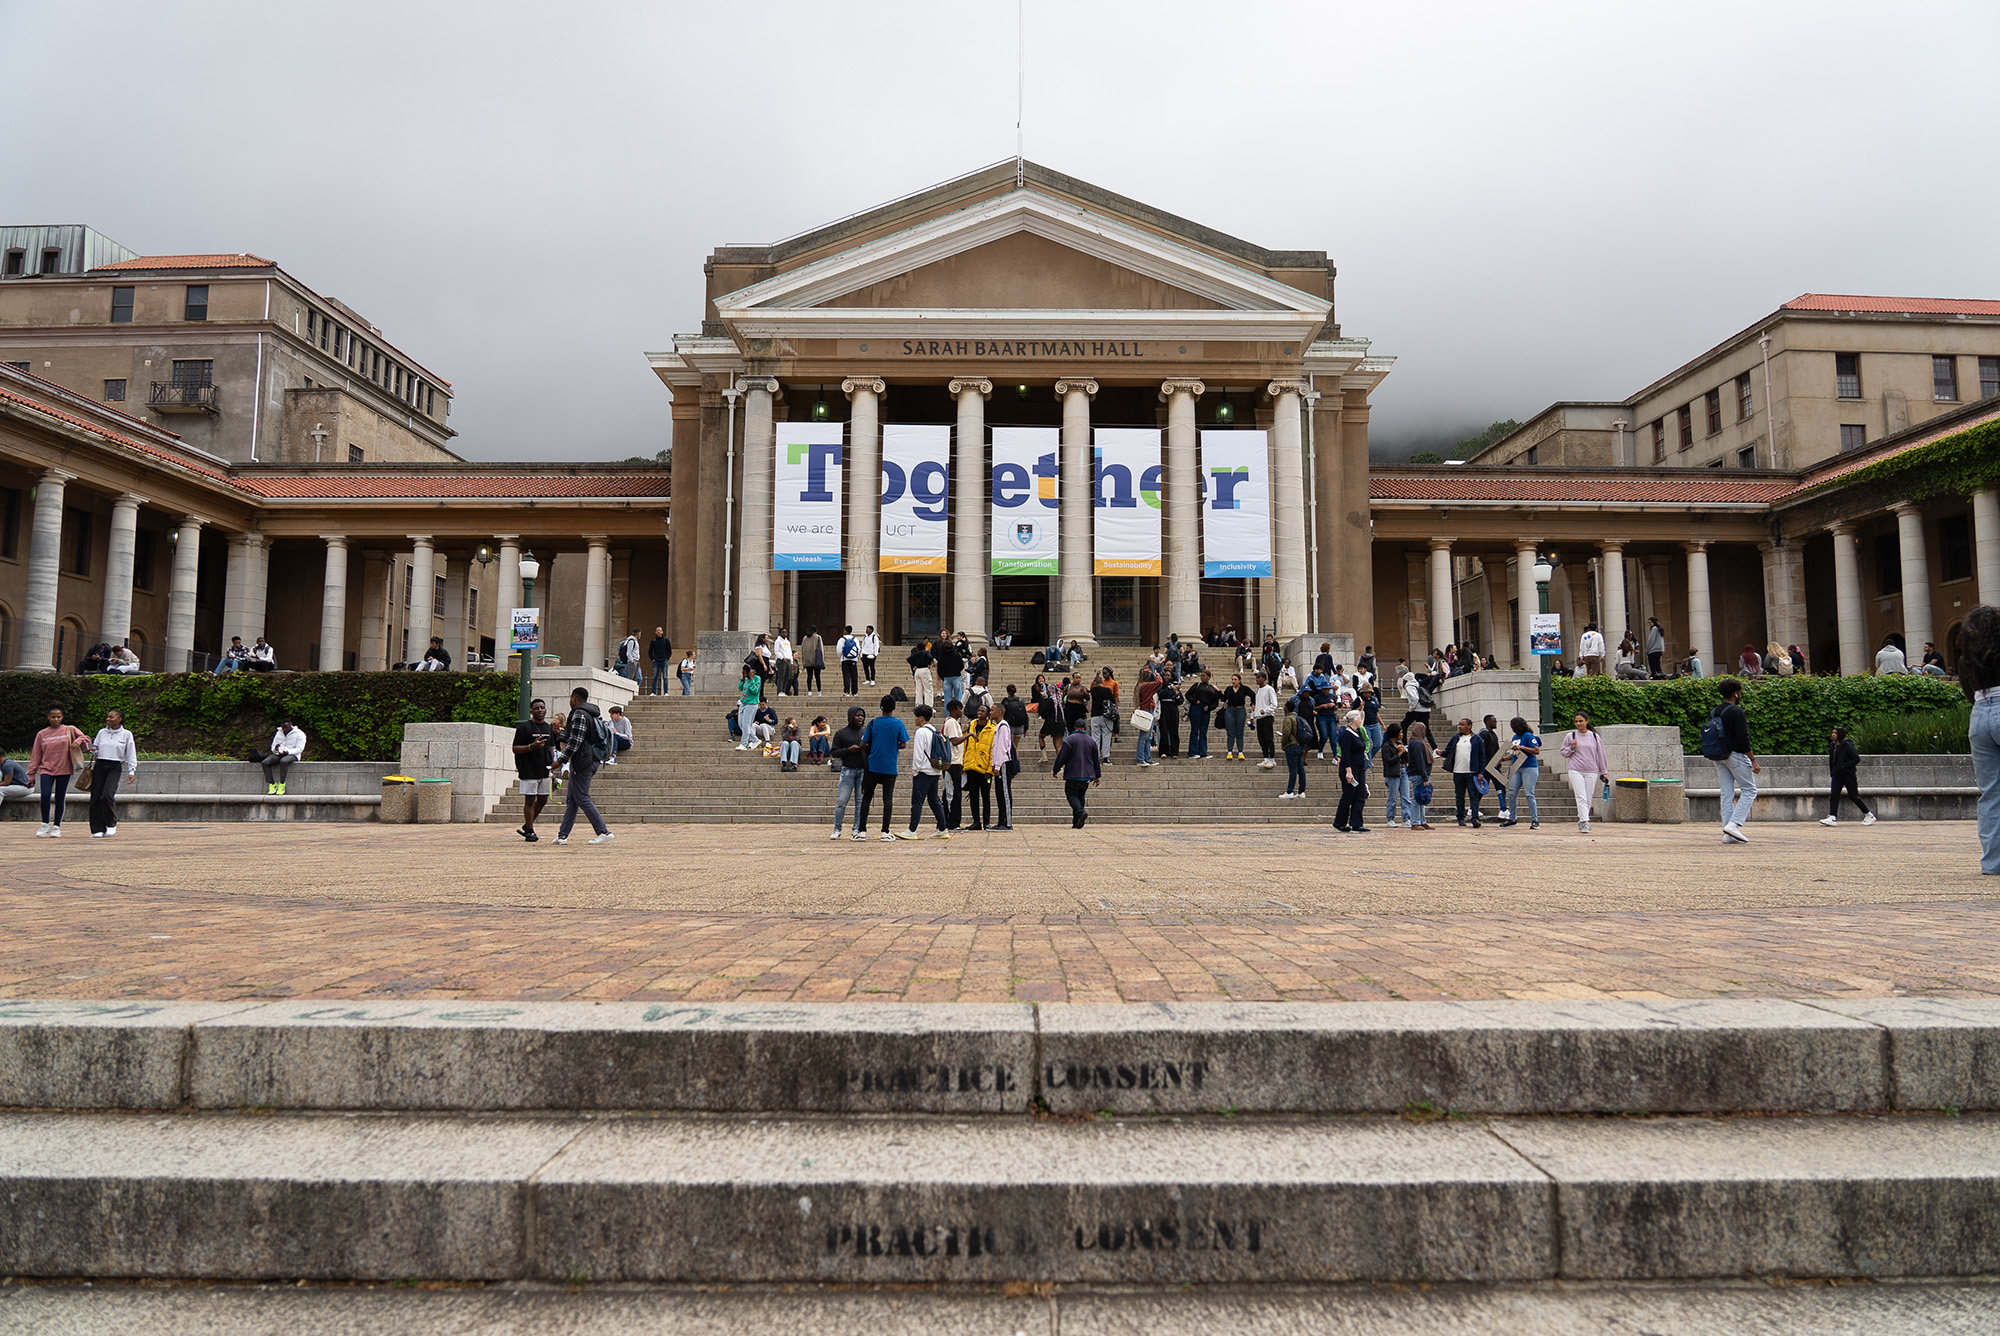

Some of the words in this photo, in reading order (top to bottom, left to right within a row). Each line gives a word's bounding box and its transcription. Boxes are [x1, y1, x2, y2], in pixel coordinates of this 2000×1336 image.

[902, 340, 968, 356] SARAH
[974, 341, 1086, 357] BAARTMAN
[1092, 342, 1144, 357] HALL
[787, 444, 1249, 521] Together
[787, 525, 807, 534] we
[811, 525, 834, 534] are
[885, 524, 917, 537] UCT
[792, 555, 822, 563] Unleash
[894, 558, 933, 566] Excellence
[997, 560, 1053, 568] Transformation
[1103, 561, 1153, 570] Sustainability
[1219, 563, 1257, 571] Inclusivity
[839, 1064, 1016, 1093] PRACTICE
